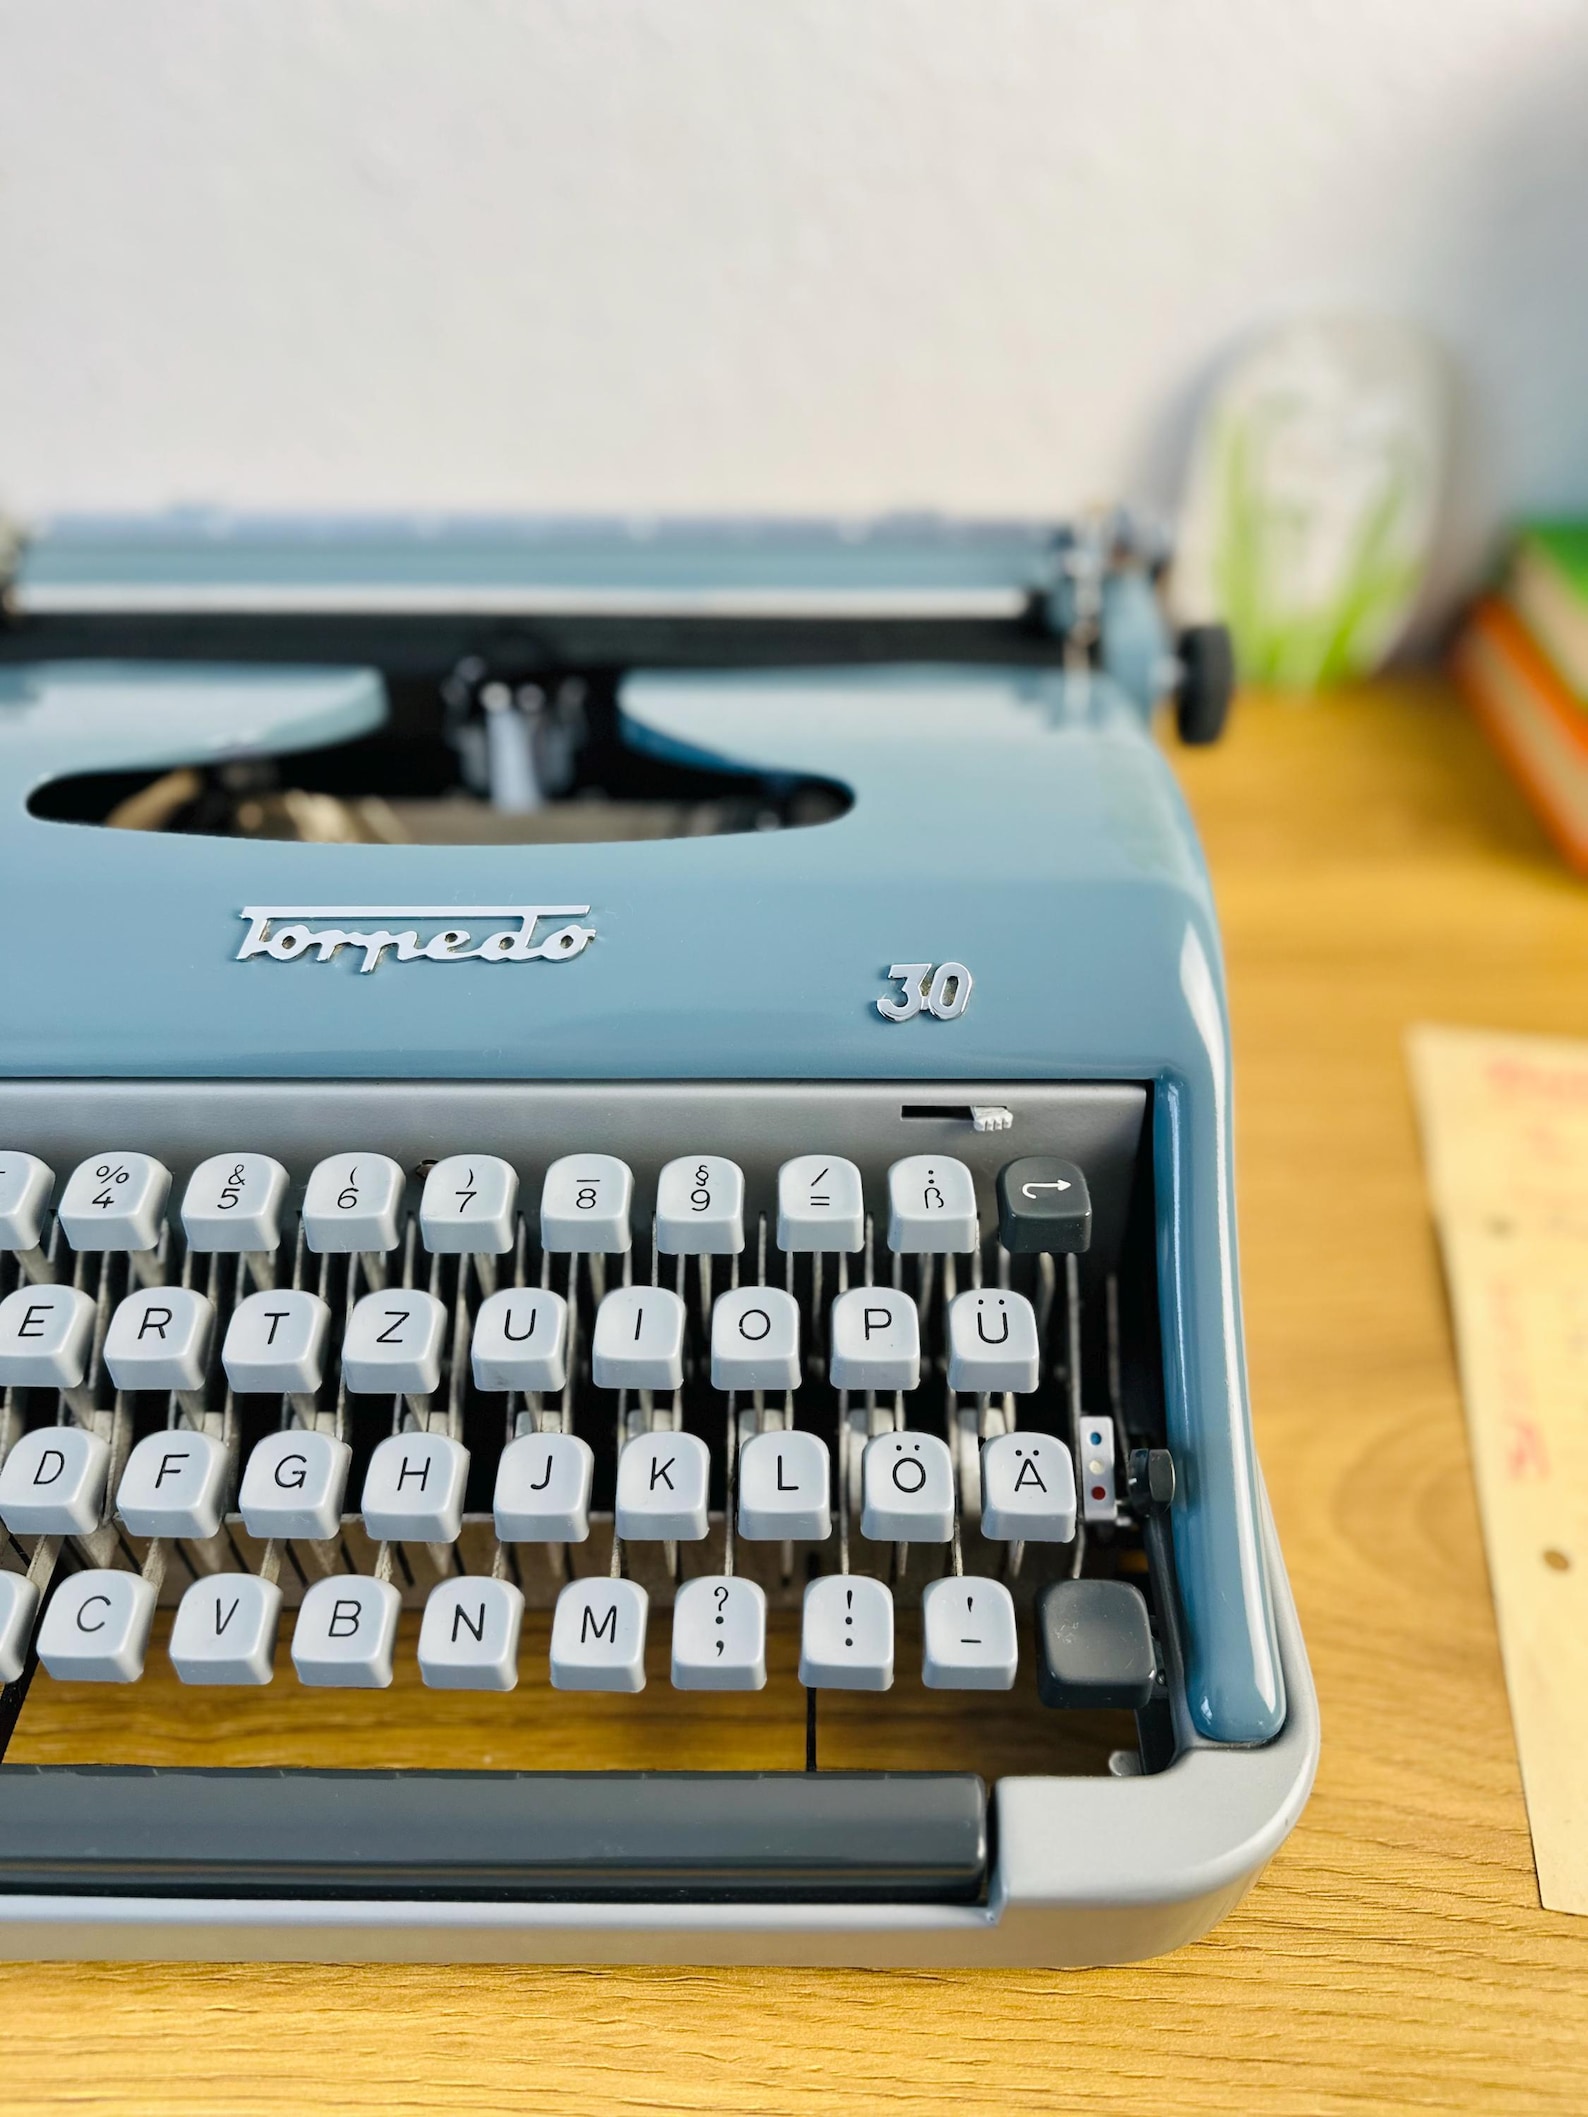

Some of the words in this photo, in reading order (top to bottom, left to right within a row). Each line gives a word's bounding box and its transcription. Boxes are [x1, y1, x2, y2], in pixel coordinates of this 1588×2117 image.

[236, 904, 597, 974] Torpedo
[875, 960, 974, 1024] 30
[95, 1165, 130, 1185] %
[227, 1163, 246, 1186] &
[349, 1166, 358, 1186] (
[465, 1168, 474, 1189] )
[695, 1164, 710, 1187] §
[810, 1167, 829, 1187] /
[91, 1187, 115, 1209] 4
[216, 1187, 241, 1210] 5
[336, 1187, 360, 1210] 6
[455, 1191, 478, 1213] 7
[575, 1187, 597, 1210] 8
[690, 1188, 711, 1212] 9
[809, 1195, 831, 1207] =
[17, 1305, 55, 1338] E
[137, 1307, 173, 1340] R
[263, 1311, 291, 1345] T
[375, 1310, 411, 1344] Z
[503, 1308, 537, 1342] U
[634, 1307, 643, 1341] I
[738, 1308, 772, 1341] O
[864, 1307, 893, 1341] P
[976, 1298, 1009, 1345] Ü
[32, 1449, 66, 1486] D
[154, 1453, 191, 1489] F
[274, 1453, 308, 1489] G
[396, 1456, 432, 1492] H
[530, 1454, 554, 1491] J
[649, 1456, 676, 1491] K
[777, 1454, 800, 1491] L
[892, 1444, 927, 1494] Ö
[1013, 1449, 1048, 1494] Ä
[76, 1595, 112, 1633] C
[215, 1597, 240, 1636] V
[327, 1599, 362, 1638] B
[450, 1602, 486, 1643] N
[713, 1586, 729, 1625] ?
[844, 1589, 853, 1626] !
[580, 1604, 618, 1644] M
